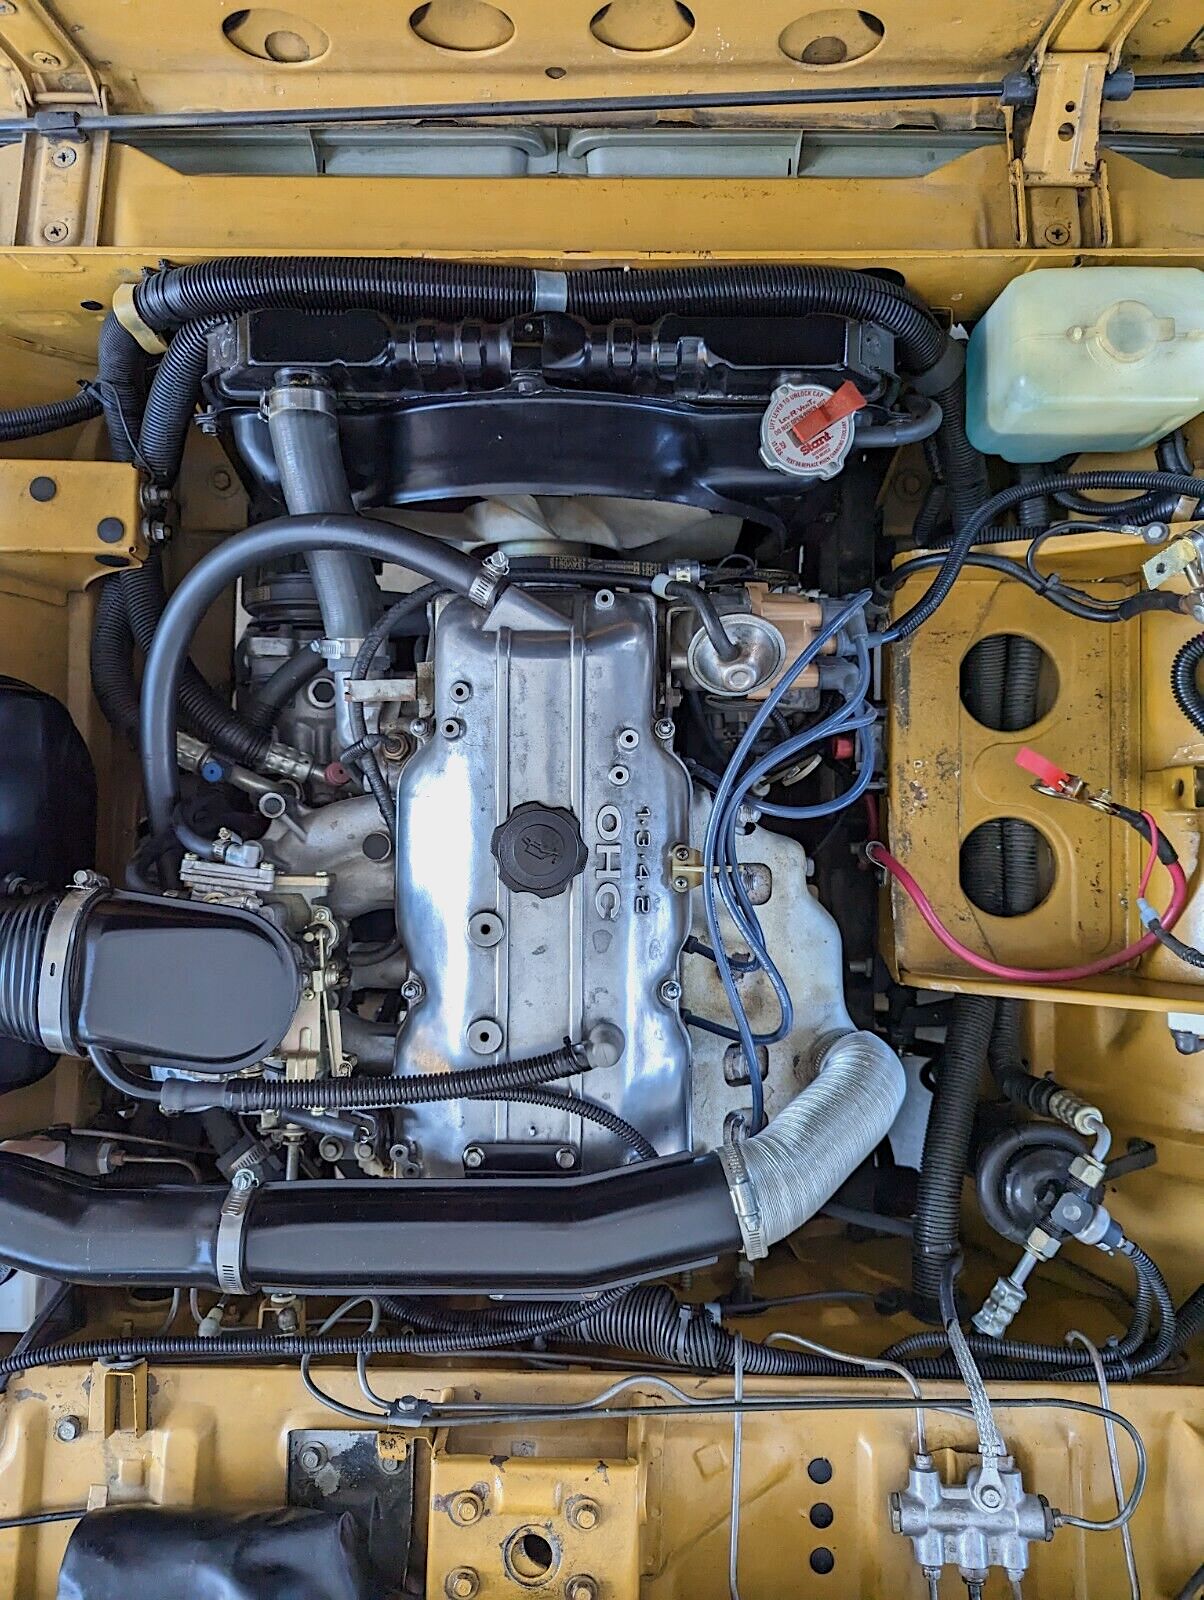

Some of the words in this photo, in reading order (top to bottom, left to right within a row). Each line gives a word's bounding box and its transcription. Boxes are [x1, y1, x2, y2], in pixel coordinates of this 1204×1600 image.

[774, 402, 783, 418] LEVER
[783, 397, 790, 406] TO
[790, 390, 812, 400] UNLOCK
[781, 422, 792, 432] NOT
[800, 431, 832, 456] Stant
[596, 804, 622, 918] OHC
